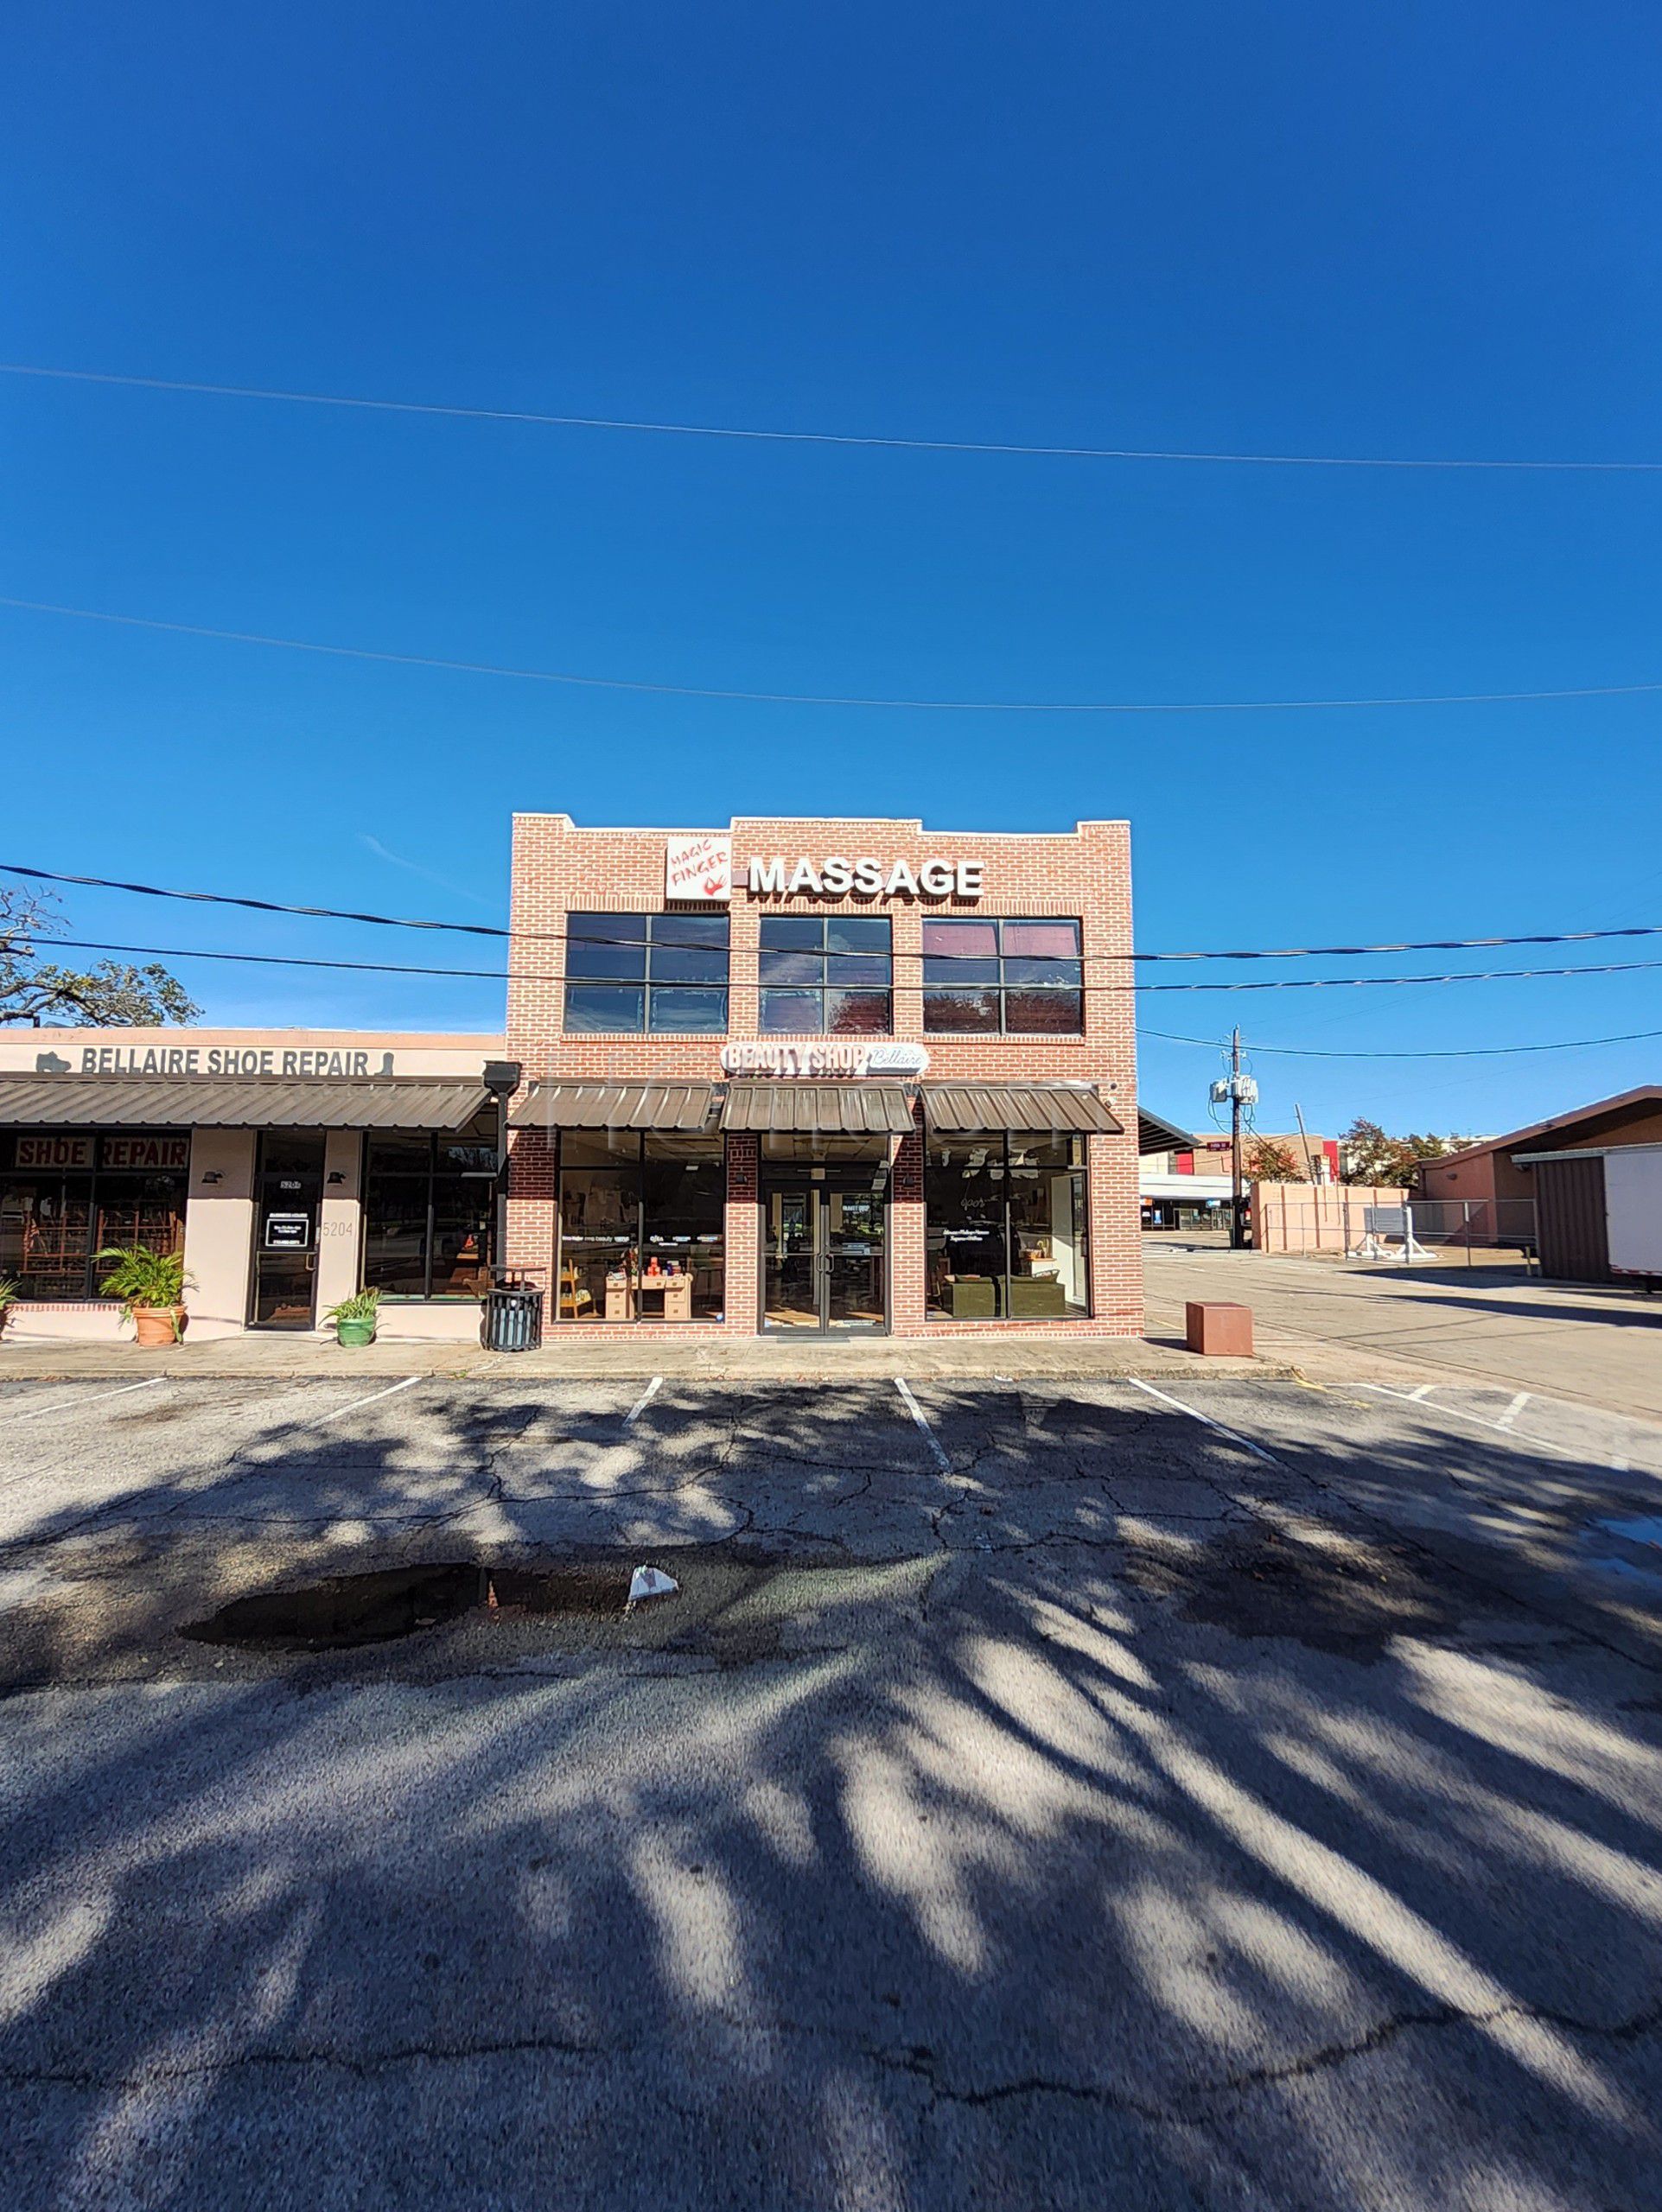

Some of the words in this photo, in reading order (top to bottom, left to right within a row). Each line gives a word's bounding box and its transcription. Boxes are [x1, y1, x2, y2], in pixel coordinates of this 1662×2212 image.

[671, 838, 713, 868] MAGIC
[671, 851, 729, 887] FINGER
[748, 856, 986, 898] MASSAGE
[80, 1047, 200, 1075] BELLAIRE
[207, 1049, 274, 1076] SHOE
[282, 1051, 368, 1077] REPAIR
[728, 1043, 807, 1070] BEAUTY
[812, 1043, 866, 1070] SHOP
[871, 1046, 925, 1065] Bellaire
[19, 1140, 86, 1165] SHOE
[102, 1141, 187, 1166] REPAIR
[322, 1222, 353, 1236] 5204
